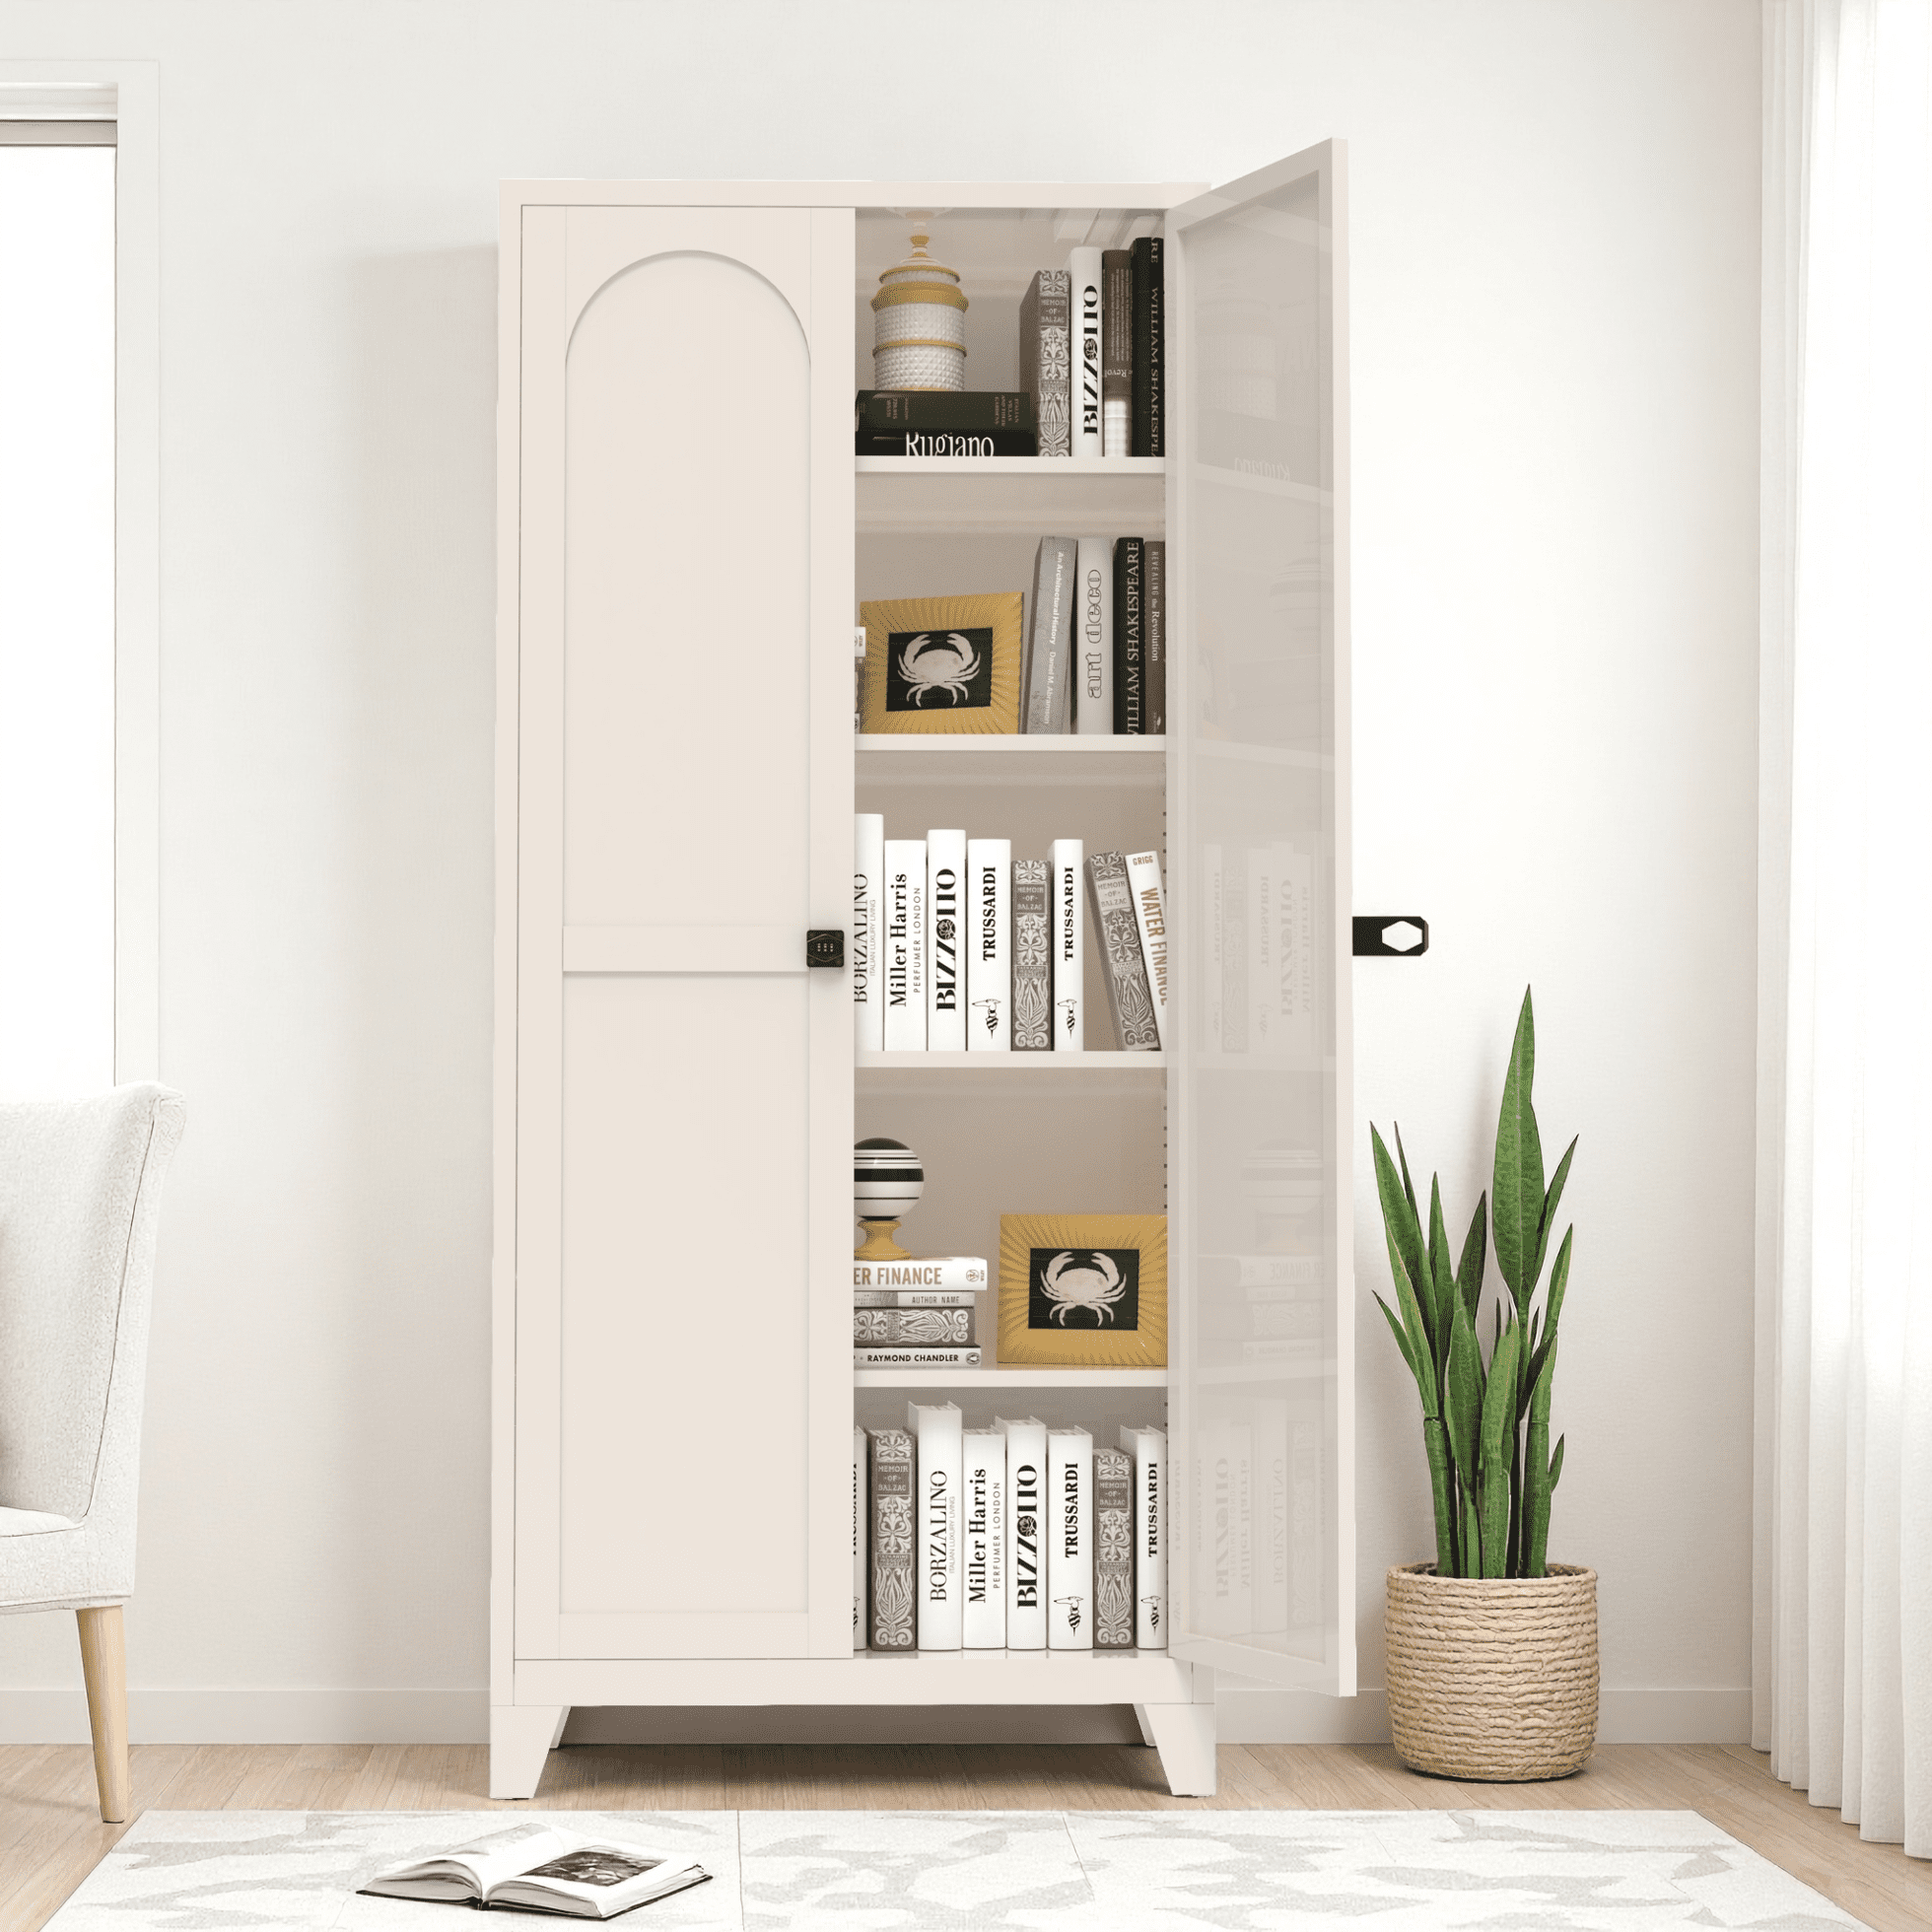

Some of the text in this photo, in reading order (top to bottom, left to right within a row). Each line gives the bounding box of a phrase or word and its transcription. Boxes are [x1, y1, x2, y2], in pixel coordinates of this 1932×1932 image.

[1049, 616, 1059, 646] History
[1052, 563, 1064, 616] Architectural
[1085, 570, 1102, 699] art deco
[1127, 542, 1139, 661] SHAKESPEARE
[1043, 686, 1054, 724] Abramson
[1048, 651, 1057, 675] Daniel
[1101, 898, 1127, 907] BALZAC
[1133, 855, 1153, 866] GRIGG
[890, 873, 907, 1007] Miller Harris
[983, 866, 996, 961] TRUSSARDI
[1065, 866, 1073, 961] TRUSSARDI
[1139, 887, 1165, 937] WATER
[876, 1268, 942, 1284] FINANCE
[930, 1470, 947, 1602] BORZALINO
[969, 1468, 986, 1603] Miller Harris
[1066, 1463, 1078, 1557] TRUSSARDI
[1147, 1462, 1157, 1557] TRUSSARDI
